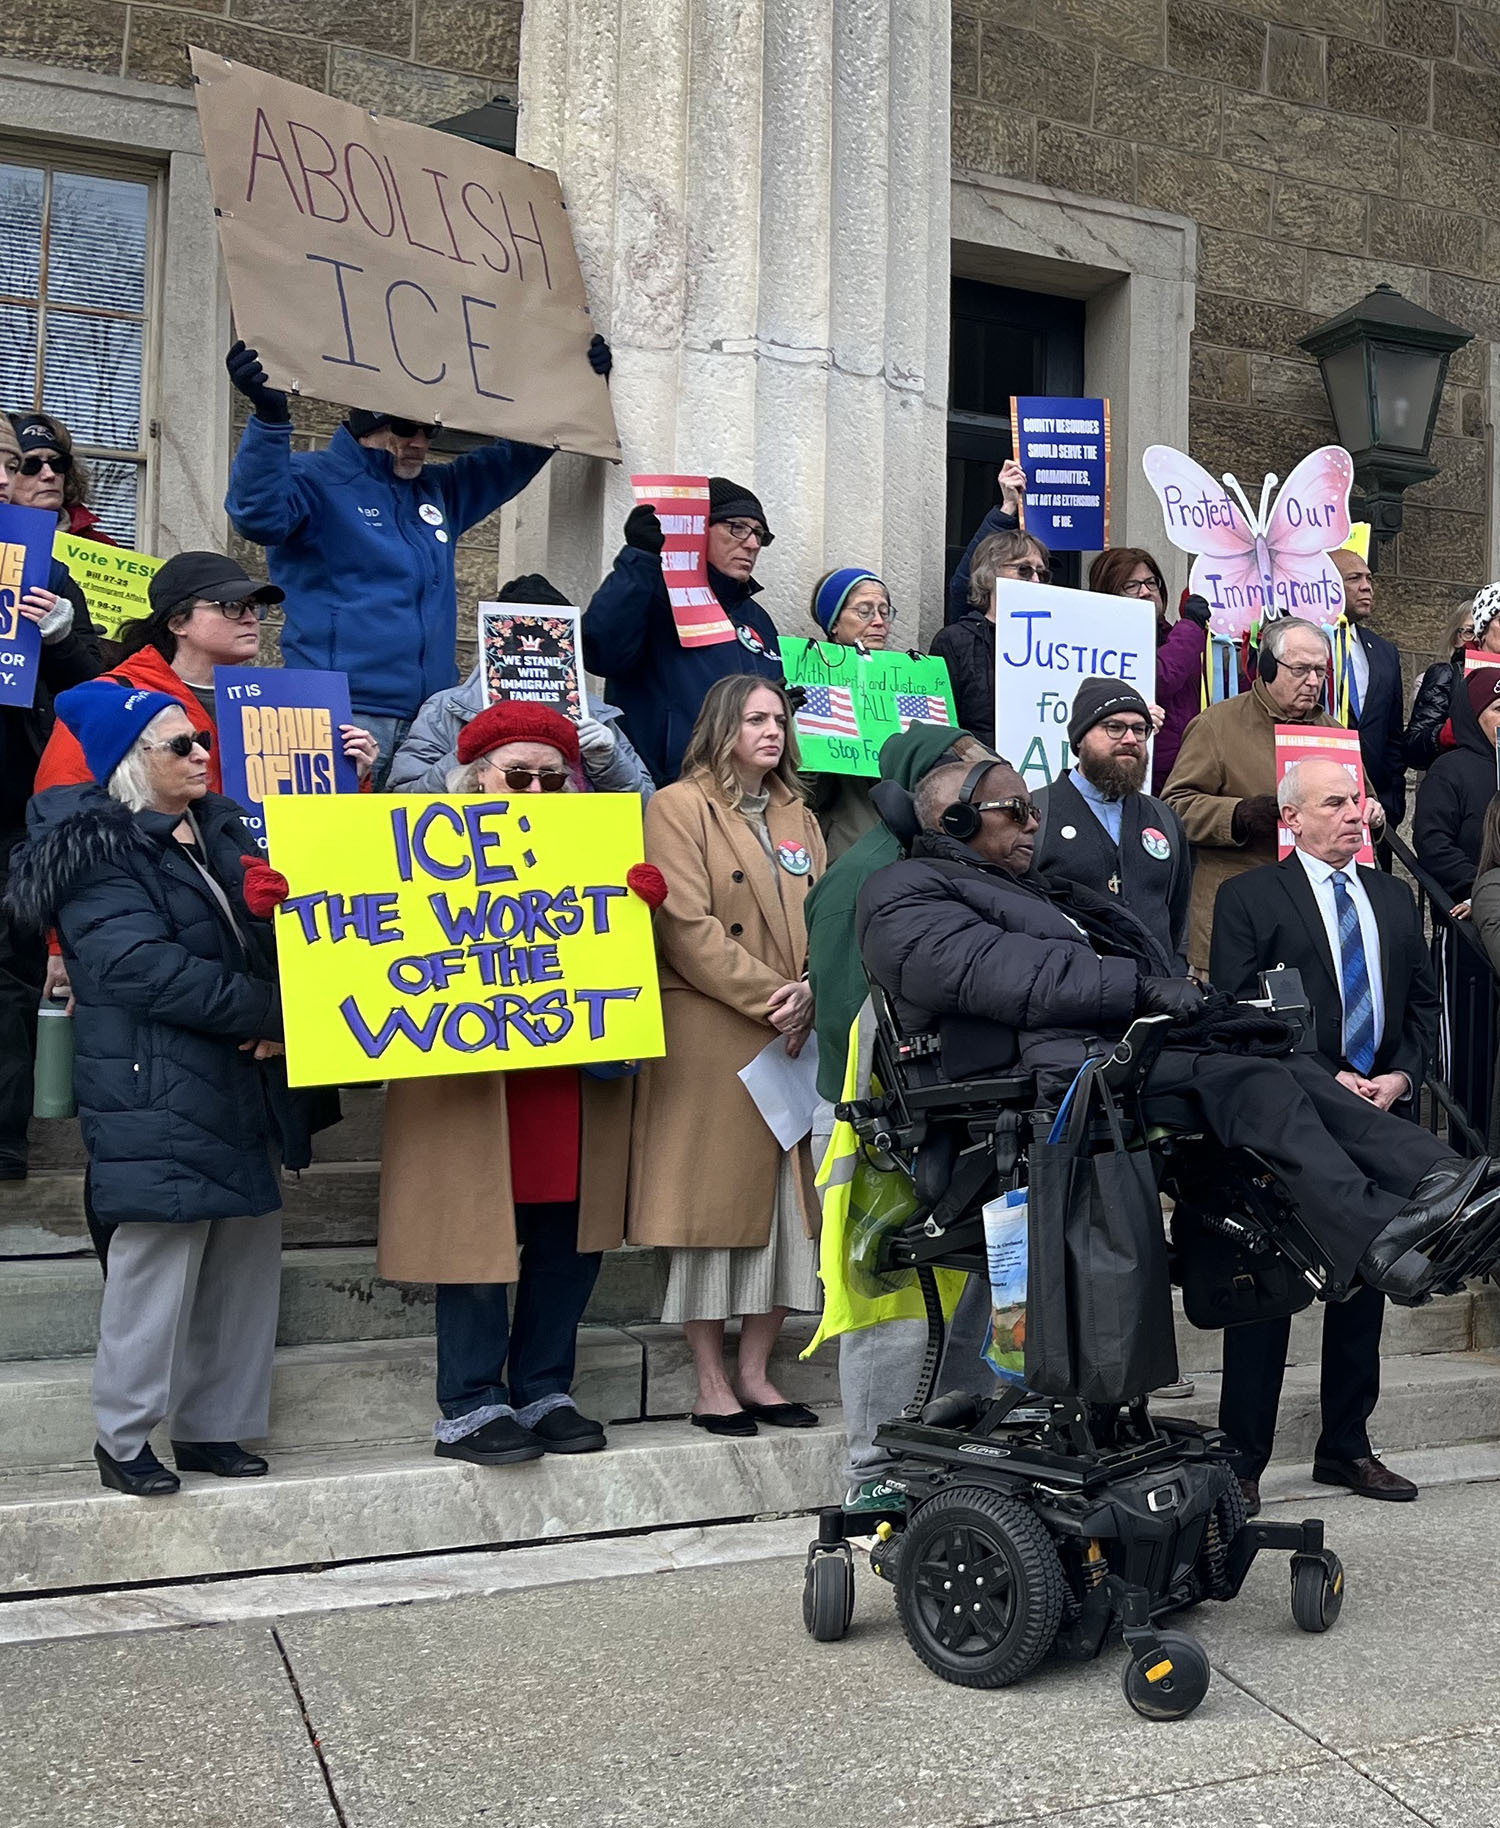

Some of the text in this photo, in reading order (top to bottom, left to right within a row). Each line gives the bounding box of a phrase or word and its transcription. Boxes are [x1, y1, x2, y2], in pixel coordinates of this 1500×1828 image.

[246, 107, 552, 290] ABOLISH
[305, 253, 515, 402] ICE
[1059, 445, 1081, 459] SERVE
[1083, 446, 1097, 460] THE
[1164, 485, 1336, 529] Protect Our
[67, 545, 108, 566] Vote
[86, 570, 128, 587] Bill 97-25
[1205, 568, 1342, 609] Immigrants
[97, 601, 122, 612] 98-25
[503, 655, 561, 667] WE STAND
[1003, 611, 1138, 680] JUSTICE
[500, 679, 566, 690] IMMIGRANT
[517, 668, 549, 678] WITH
[868, 671, 886, 691] and
[889, 666, 927, 694] Justice
[934, 677, 946, 691] for
[227, 684, 261, 699] IT IS
[509, 691, 560, 702] FAMILIES
[863, 695, 893, 722] ALL
[241, 706, 333, 755] BRAVE
[827, 736, 860, 769] Stop
[245, 752, 331, 803] OF US
[391, 801, 537, 886] ICE:
[280, 886, 628, 946] THE WORST
[388, 942, 564, 995] OF THE
[339, 986, 643, 1059] WORST
